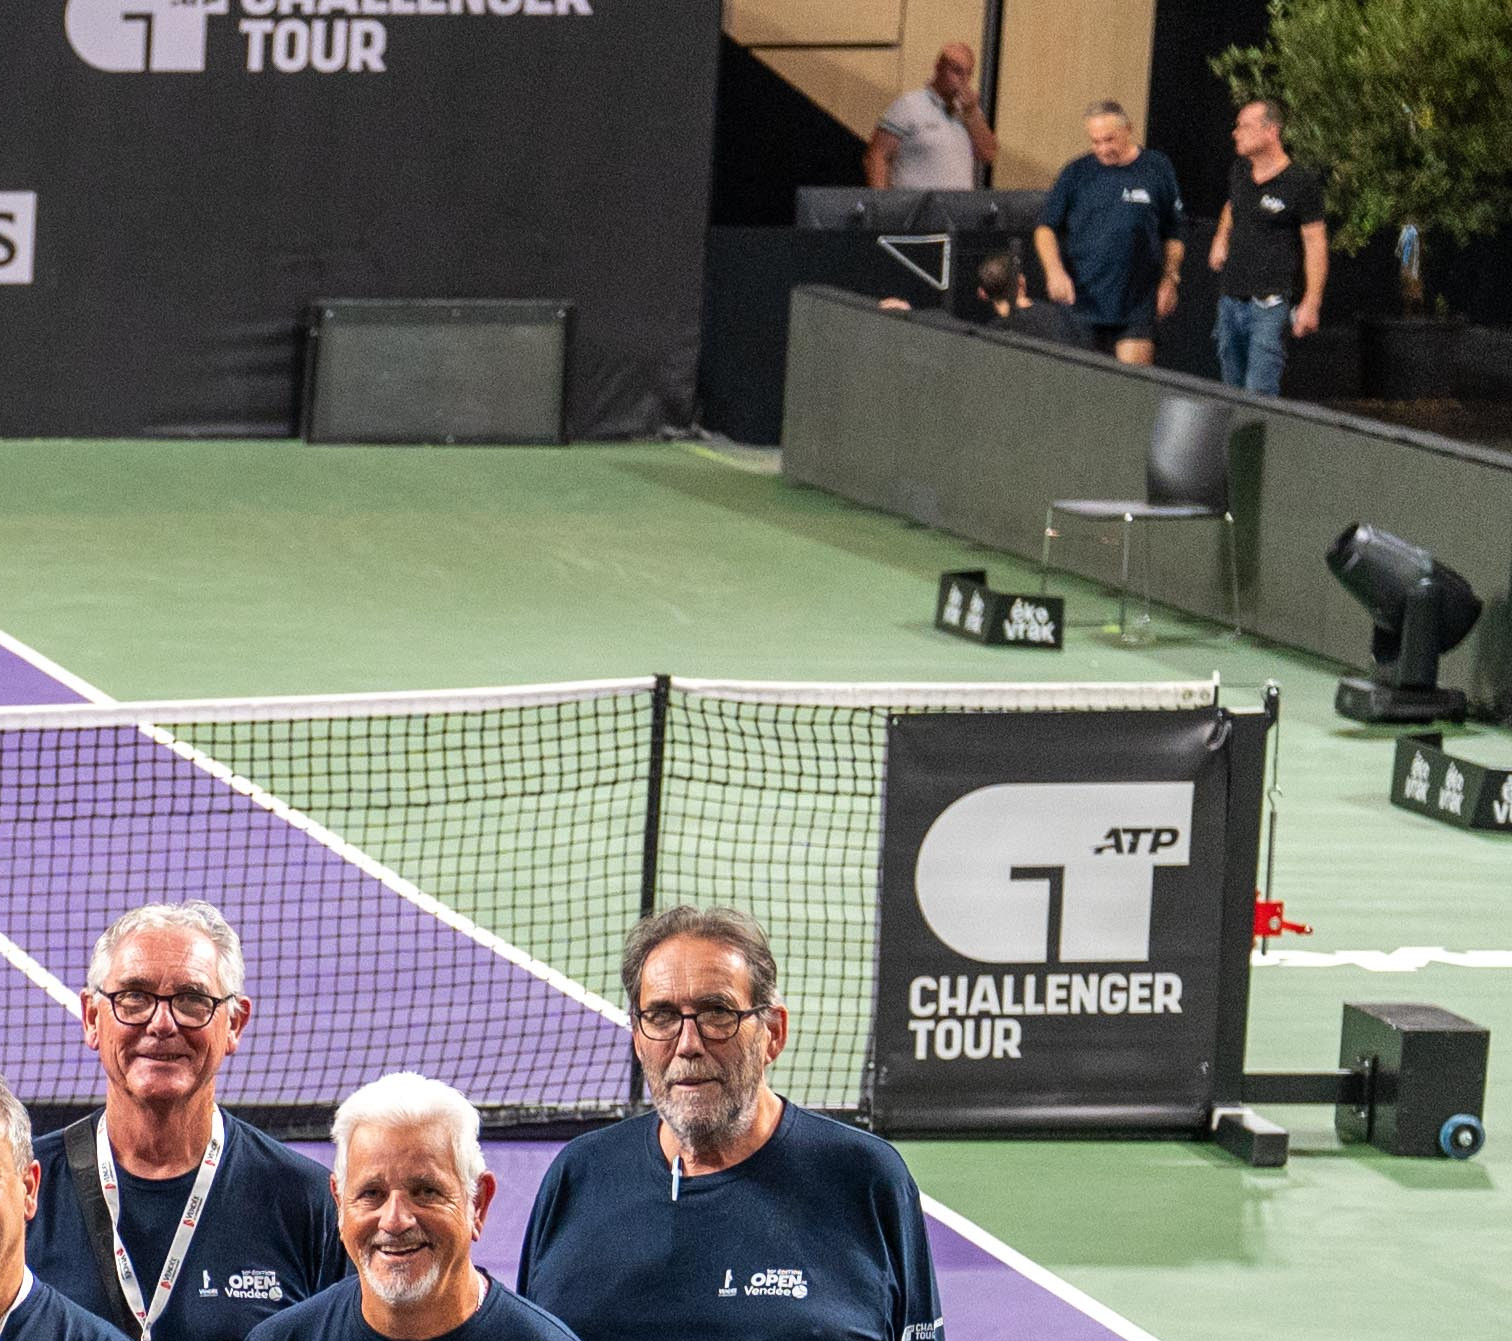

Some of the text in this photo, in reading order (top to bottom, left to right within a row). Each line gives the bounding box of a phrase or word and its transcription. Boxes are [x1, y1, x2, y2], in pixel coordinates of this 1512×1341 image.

[240, 18, 387, 73] TOUR
[1093, 827, 1180, 855] ATP
[908, 973, 1182, 1017] CHALLENGER
[907, 1018, 1022, 1060] TOUR
[229, 1275, 275, 1289] OPEN
[744, 1285, 791, 1297] Vendée
[750, 1272, 802, 1288] OPEN
[225, 1287, 268, 1299] Vendée
